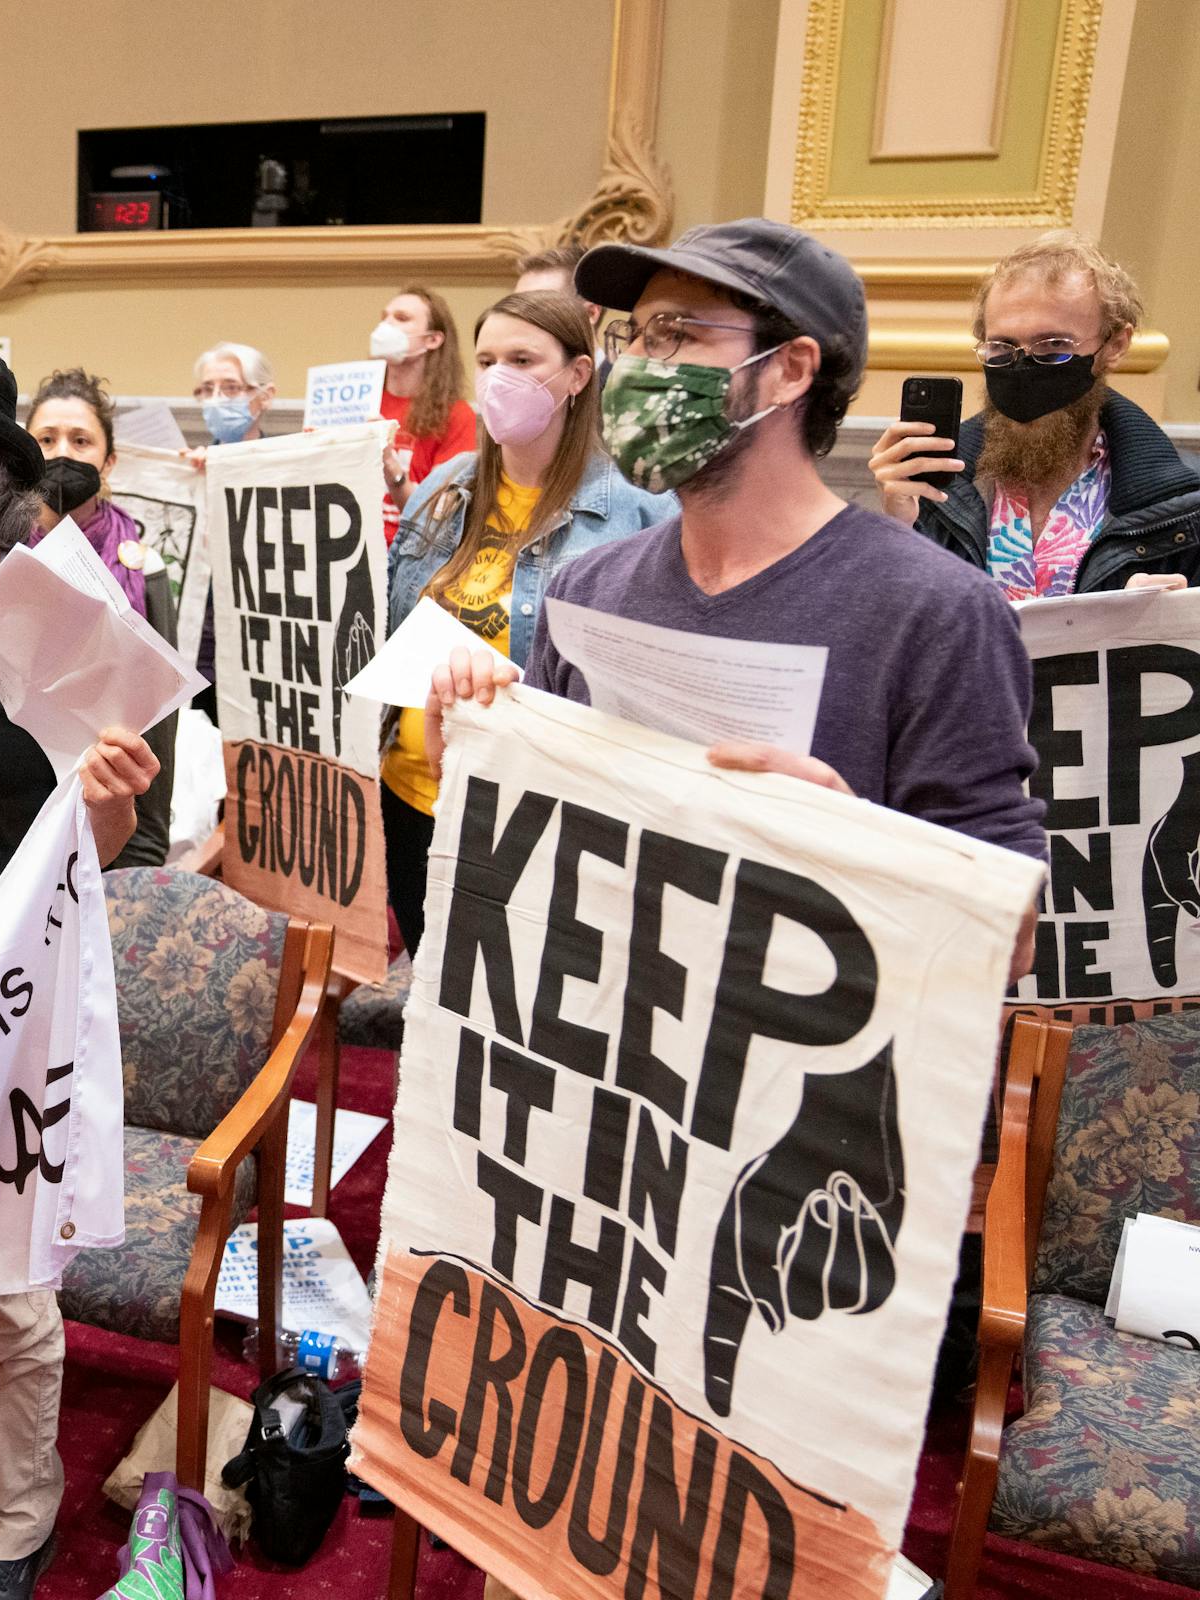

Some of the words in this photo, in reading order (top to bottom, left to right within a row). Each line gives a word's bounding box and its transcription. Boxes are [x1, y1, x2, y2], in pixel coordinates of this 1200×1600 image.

[312, 384, 373, 406] STOP
[224, 483, 363, 622] KEEP
[240, 615, 271, 674] IT
[282, 620, 322, 687] IN
[250, 679, 321, 755] THE
[1028, 643, 1200, 830] EP
[237, 744, 366, 907] GROUND
[438, 775, 880, 1151] KEEP
[453, 1025, 557, 1168] IT
[583, 1085, 690, 1261] IN
[477, 1149, 667, 1378] THE
[400, 1258, 797, 1600] GROUND
